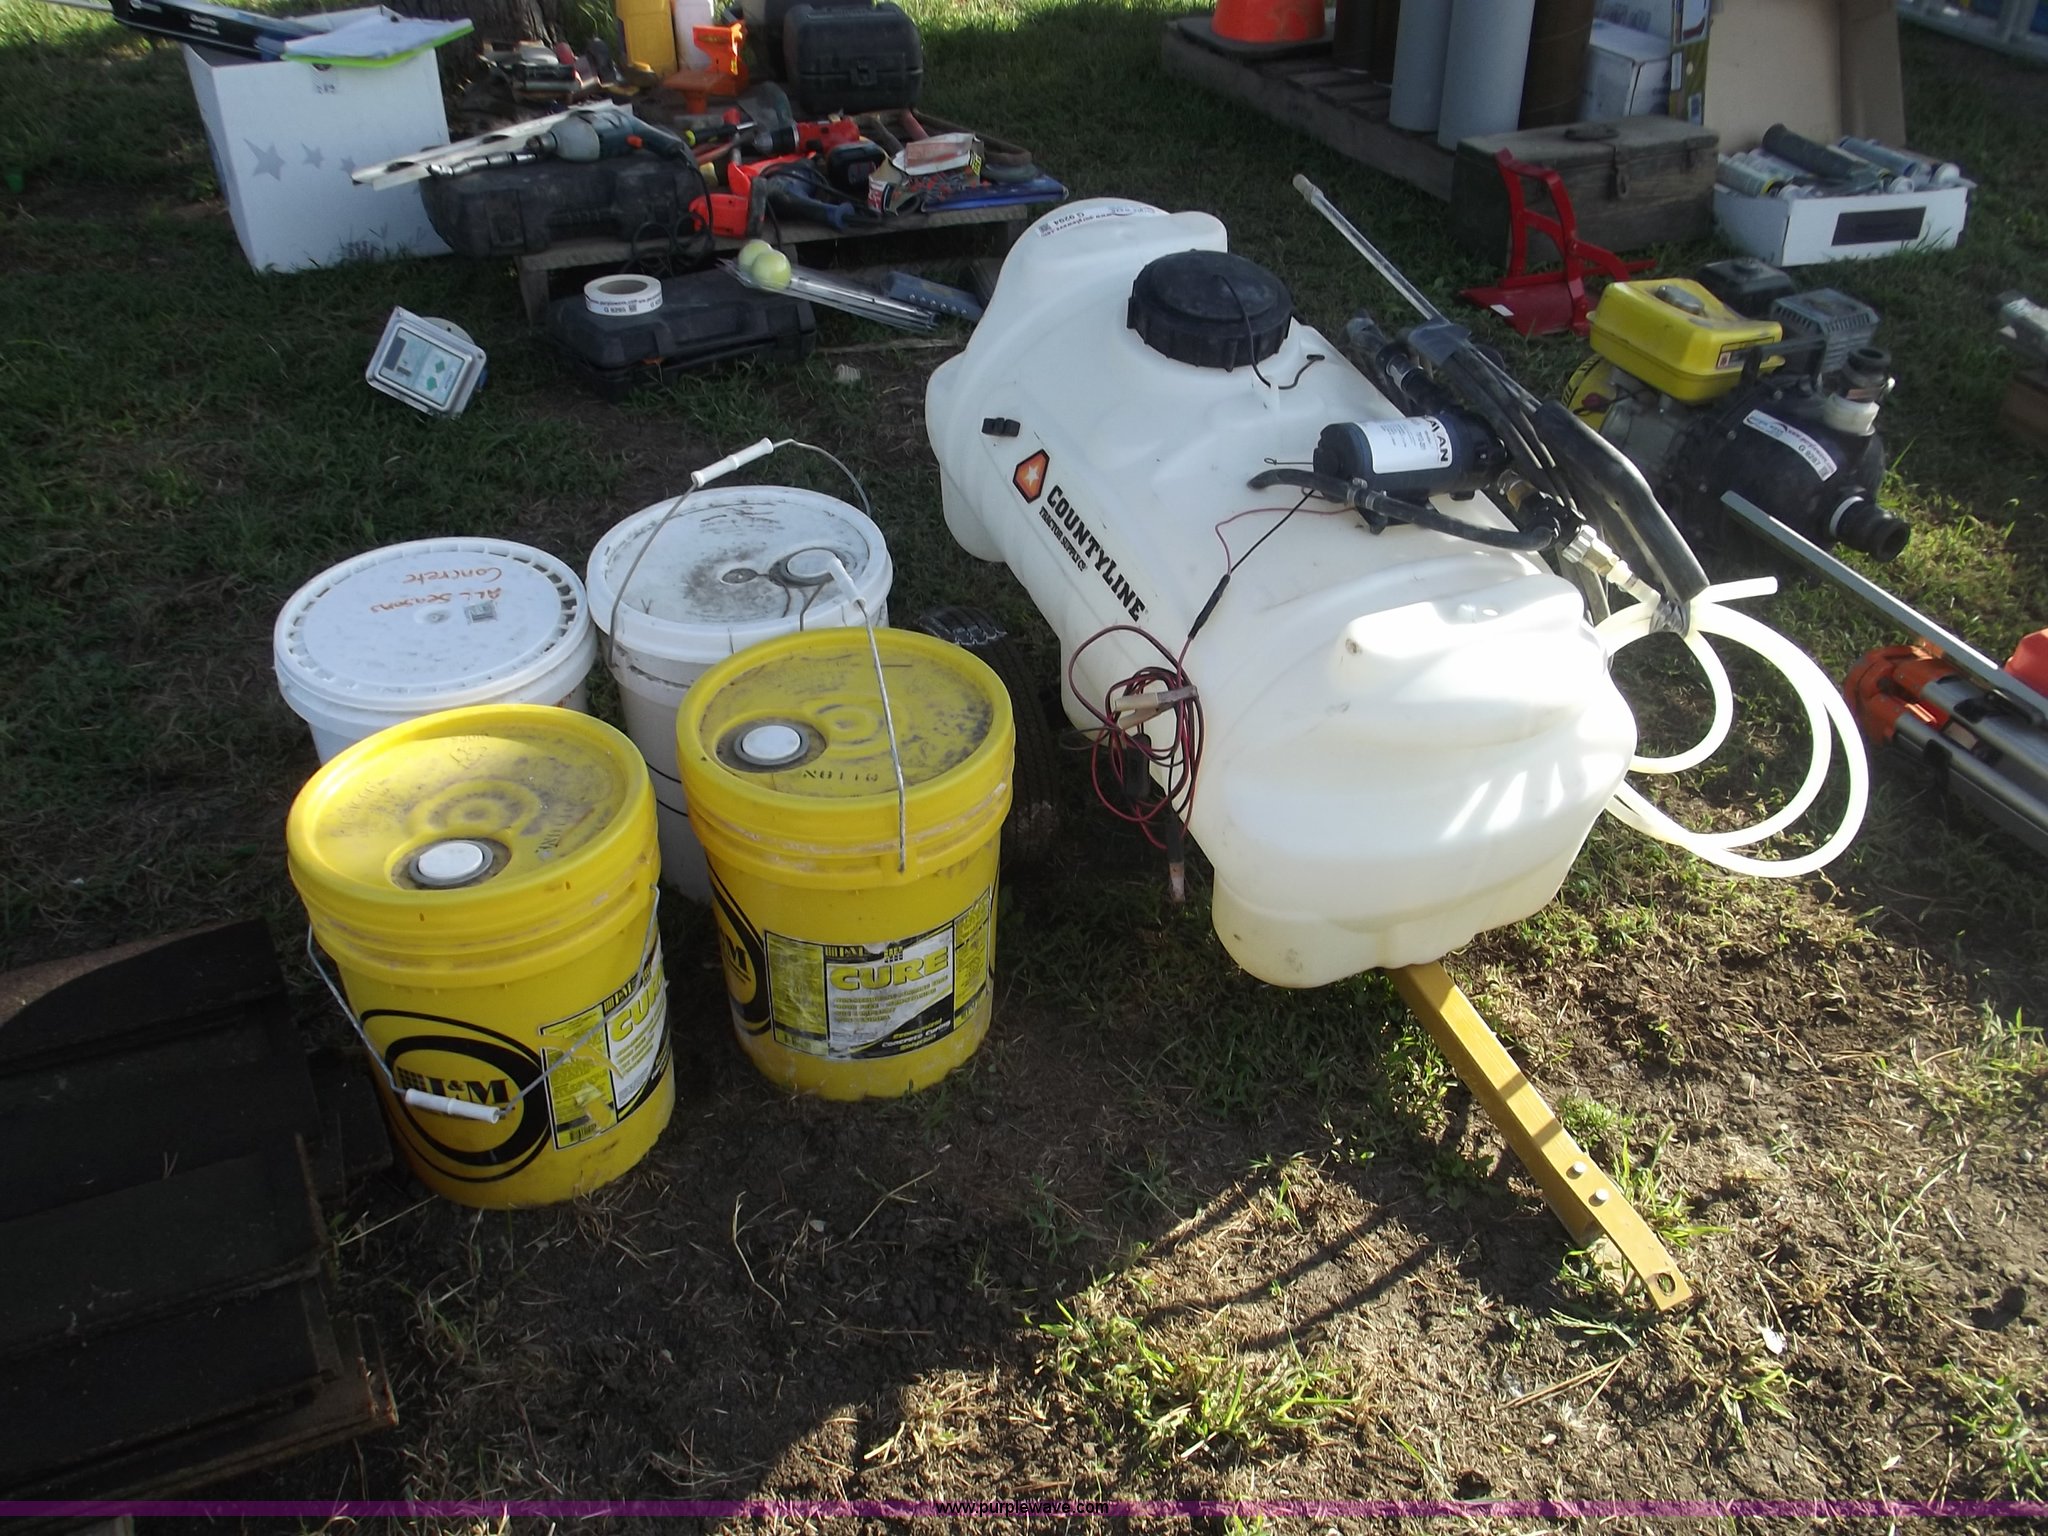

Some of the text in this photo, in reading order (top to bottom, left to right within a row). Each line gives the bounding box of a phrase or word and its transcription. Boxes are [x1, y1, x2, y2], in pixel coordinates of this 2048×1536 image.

[1039, 506, 1064, 541] TRACTOR
[1060, 536, 1081, 564] SUPPLY
[1046, 484, 1146, 623] COUNTYLINE
[829, 946, 950, 992] CURE
